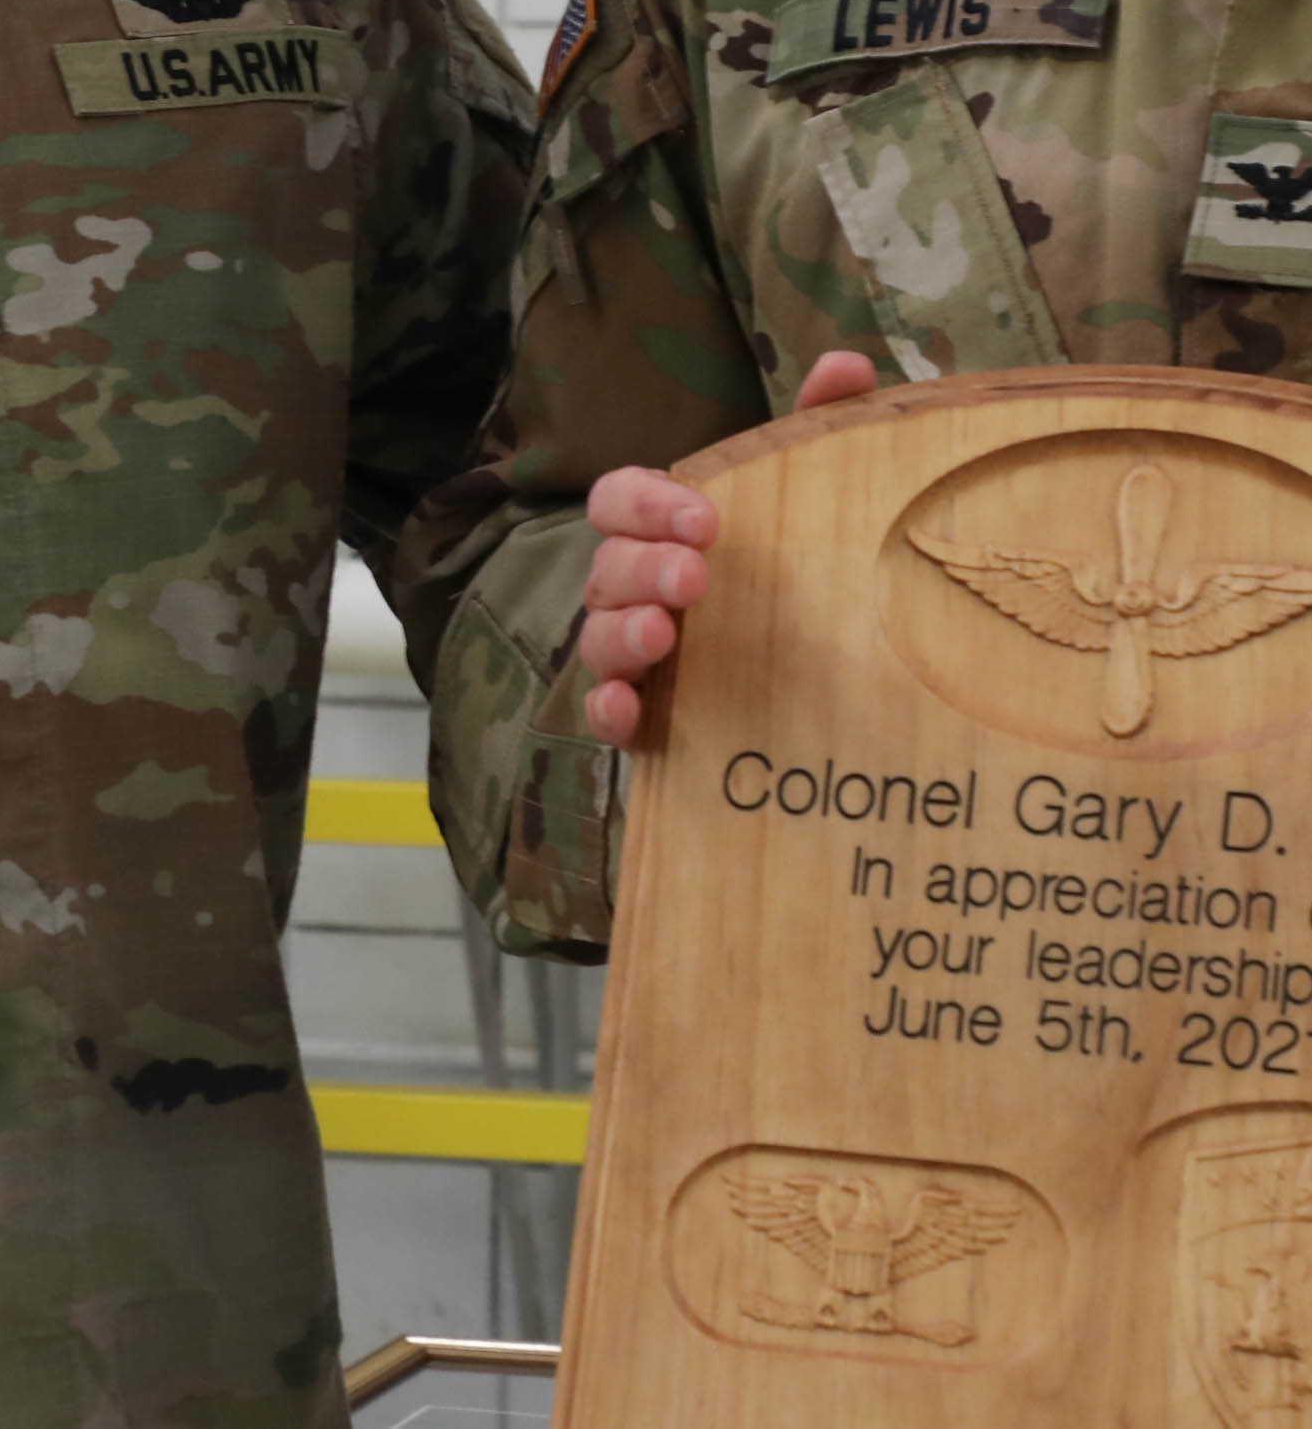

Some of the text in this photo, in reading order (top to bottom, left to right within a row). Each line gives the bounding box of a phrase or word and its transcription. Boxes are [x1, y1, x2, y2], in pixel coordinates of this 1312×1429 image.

[722, 751, 977, 830] Colonel
[1014, 774, 1183, 861] Gary
[1221, 791, 1289, 856] D.
[851, 846, 894, 899] In
[925, 863, 1277, 933] appreciation
[869, 924, 996, 980] your
[862, 985, 1003, 1047] June
